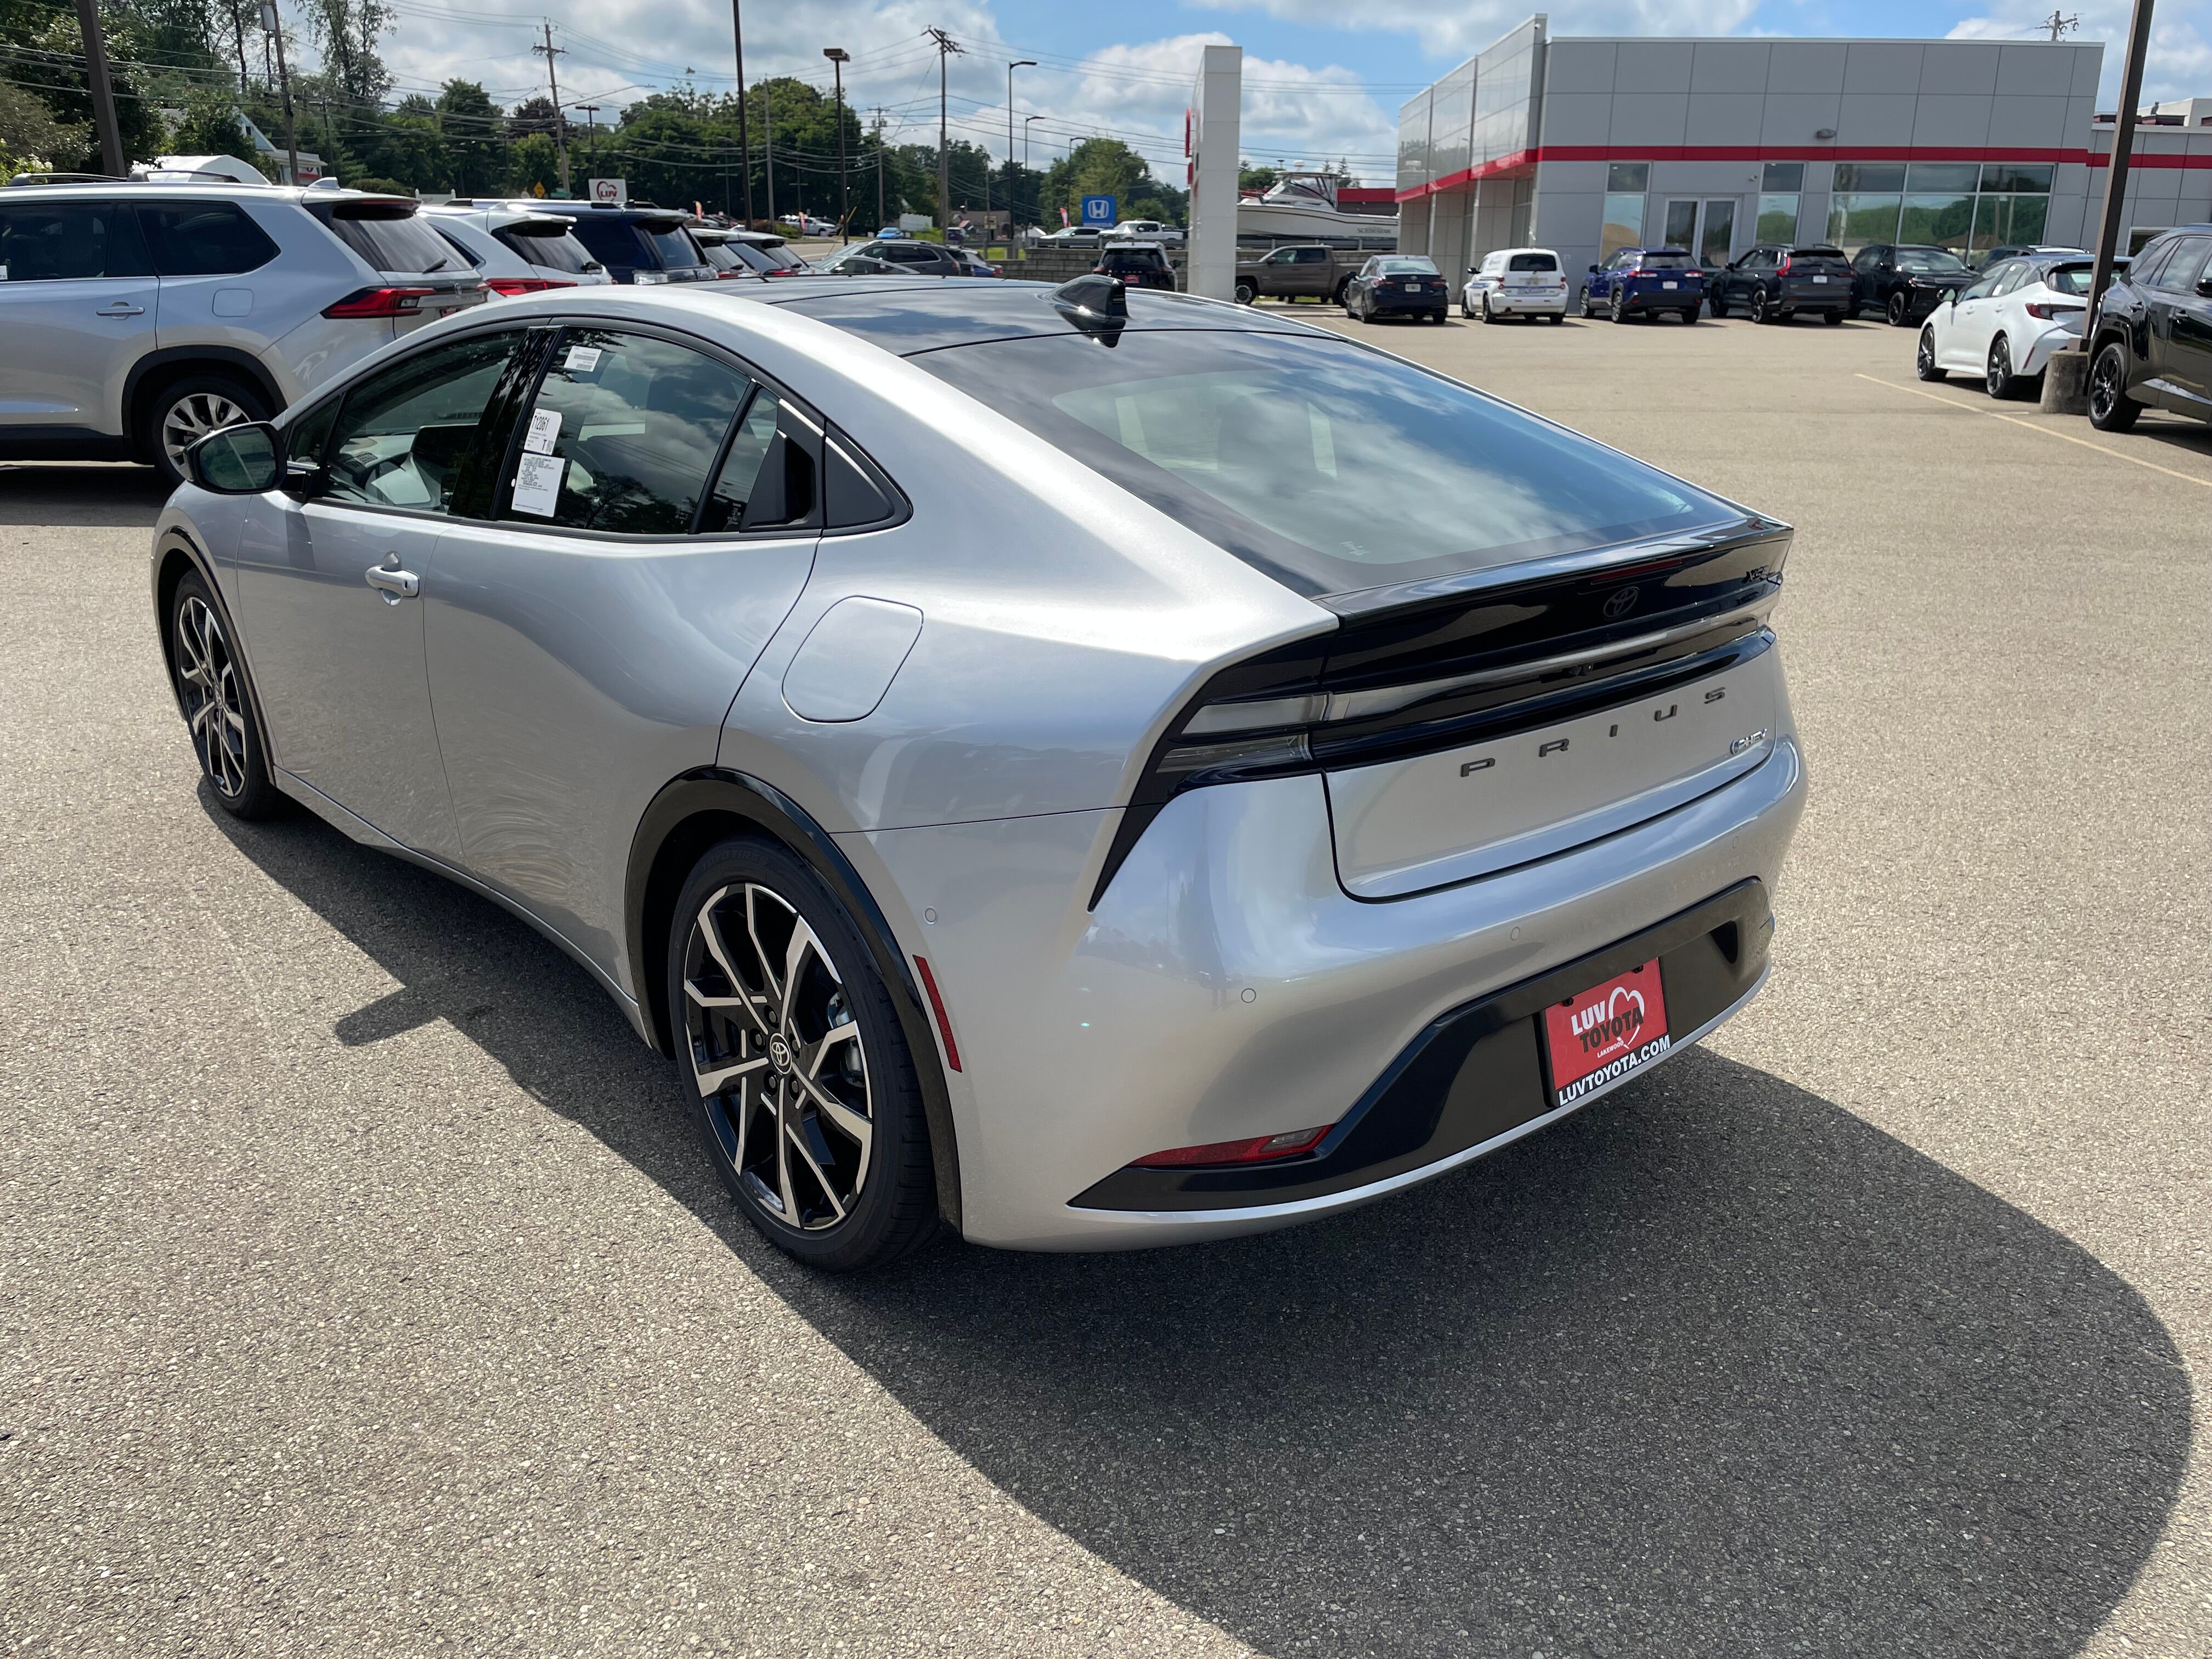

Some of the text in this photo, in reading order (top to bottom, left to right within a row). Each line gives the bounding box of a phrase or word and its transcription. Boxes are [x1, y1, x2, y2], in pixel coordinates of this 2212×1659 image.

[541, 439, 548, 451] T
[1460, 687, 1726, 777] PRIUS
[1571, 1000, 1605, 1036] LUV
[1579, 1006, 1644, 1053] TOYOTA
[1597, 1040, 1624, 1058] LAKEWOOD
[1558, 1034, 1671, 1106] LUVTOYOTA.COM
